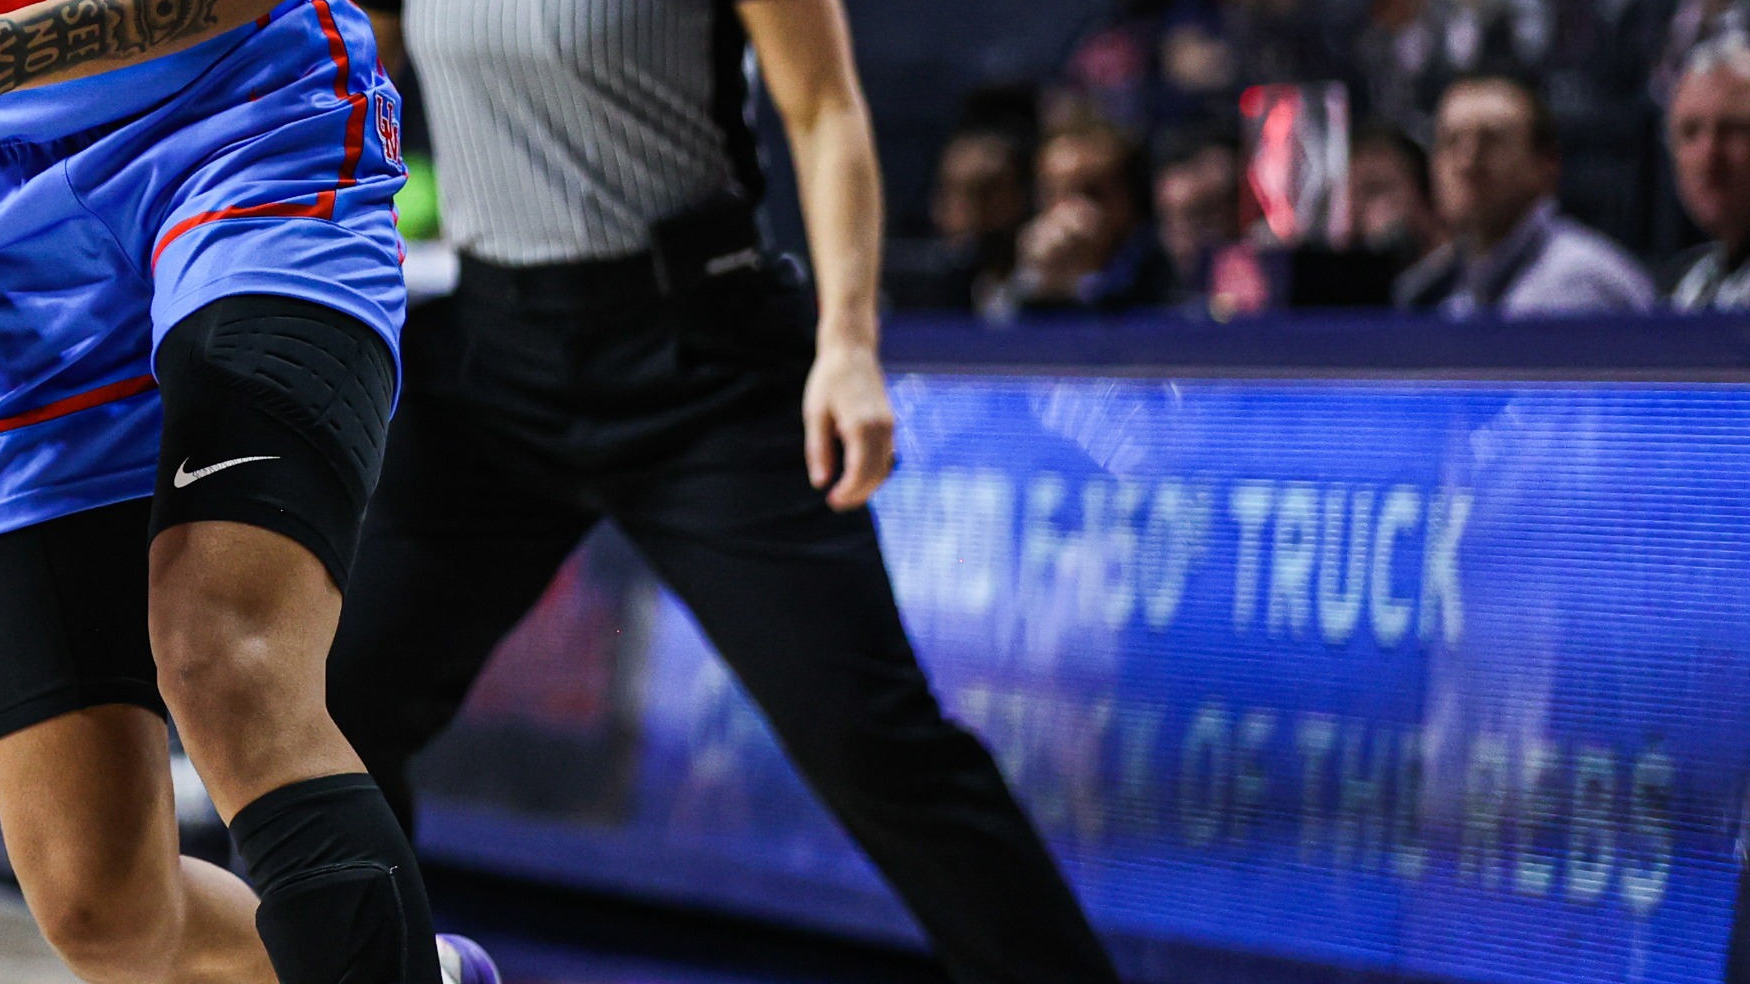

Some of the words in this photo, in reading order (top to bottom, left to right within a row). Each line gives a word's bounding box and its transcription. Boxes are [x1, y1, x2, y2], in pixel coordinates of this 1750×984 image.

[23, 18, 59, 73] NO
[1230, 476, 1475, 650] TRUCK
[1458, 731, 1676, 908] REBS
